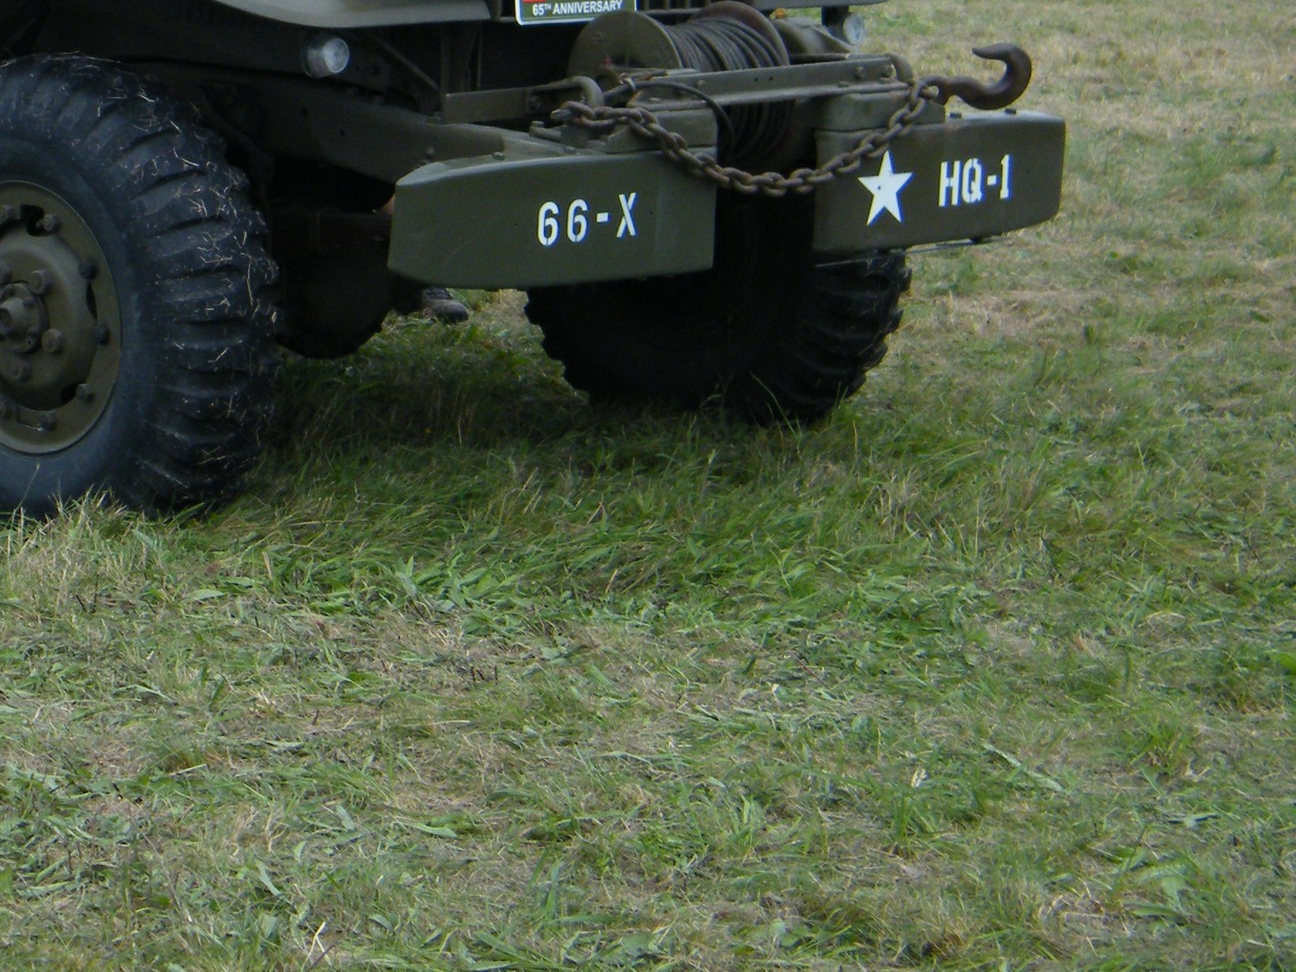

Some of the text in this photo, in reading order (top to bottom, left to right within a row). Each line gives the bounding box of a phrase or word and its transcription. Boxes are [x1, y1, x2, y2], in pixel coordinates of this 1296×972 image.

[553, 0, 623, 15] ANNIVERSARY
[938, 154, 1010, 207] HQ-1
[537, 192, 636, 246] 66-X
